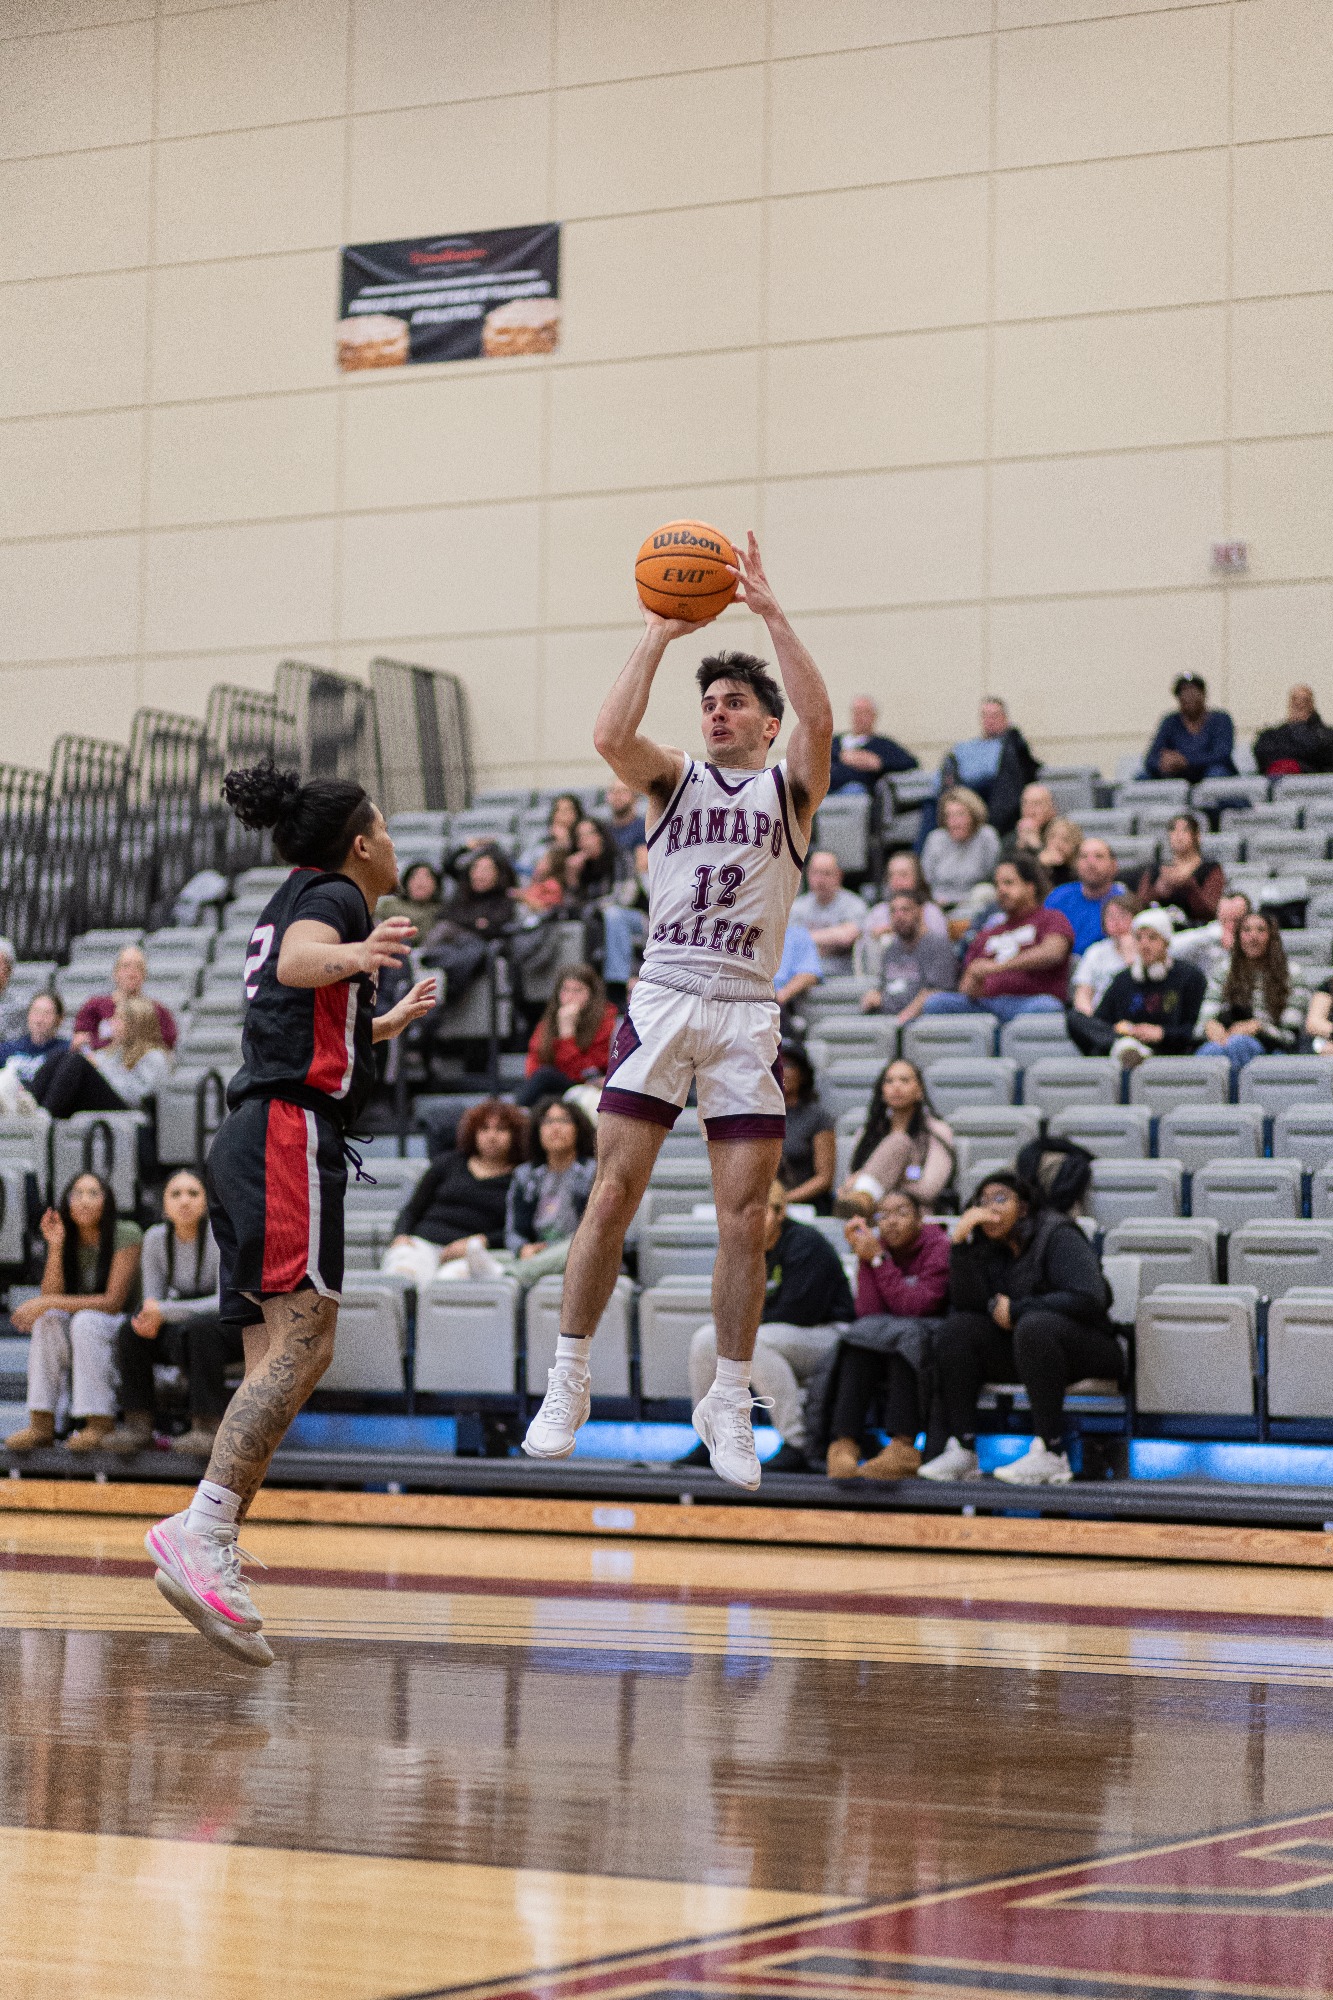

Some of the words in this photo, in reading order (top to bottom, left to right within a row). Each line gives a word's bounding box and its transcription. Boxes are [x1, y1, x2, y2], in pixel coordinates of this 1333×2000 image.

[652, 530, 721, 555] Wilson
[665, 807, 783, 859] RAMAPO
[690, 864, 746, 912] 12
